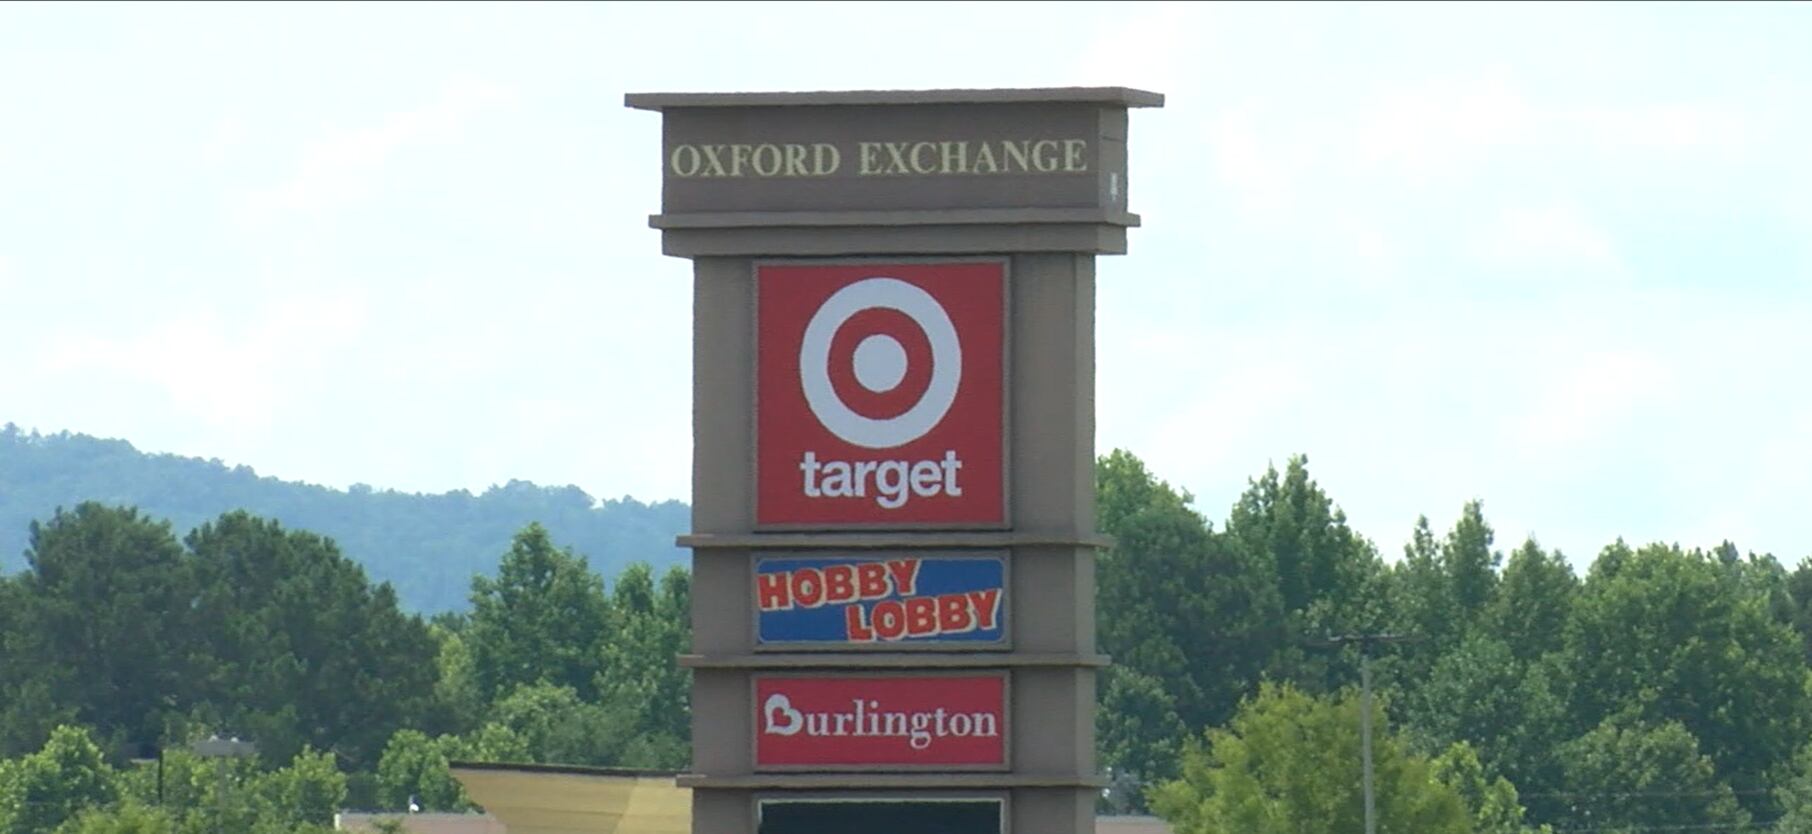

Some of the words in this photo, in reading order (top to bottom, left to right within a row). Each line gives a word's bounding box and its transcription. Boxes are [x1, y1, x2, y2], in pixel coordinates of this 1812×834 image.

[670, 143, 840, 177] OXFORD
[859, 139, 1088, 176] EXCHANGE
[800, 450, 962, 509] target
[757, 558, 922, 612] HOBBY
[845, 588, 1002, 643] LOBBY
[764, 692, 998, 750] Burlington
